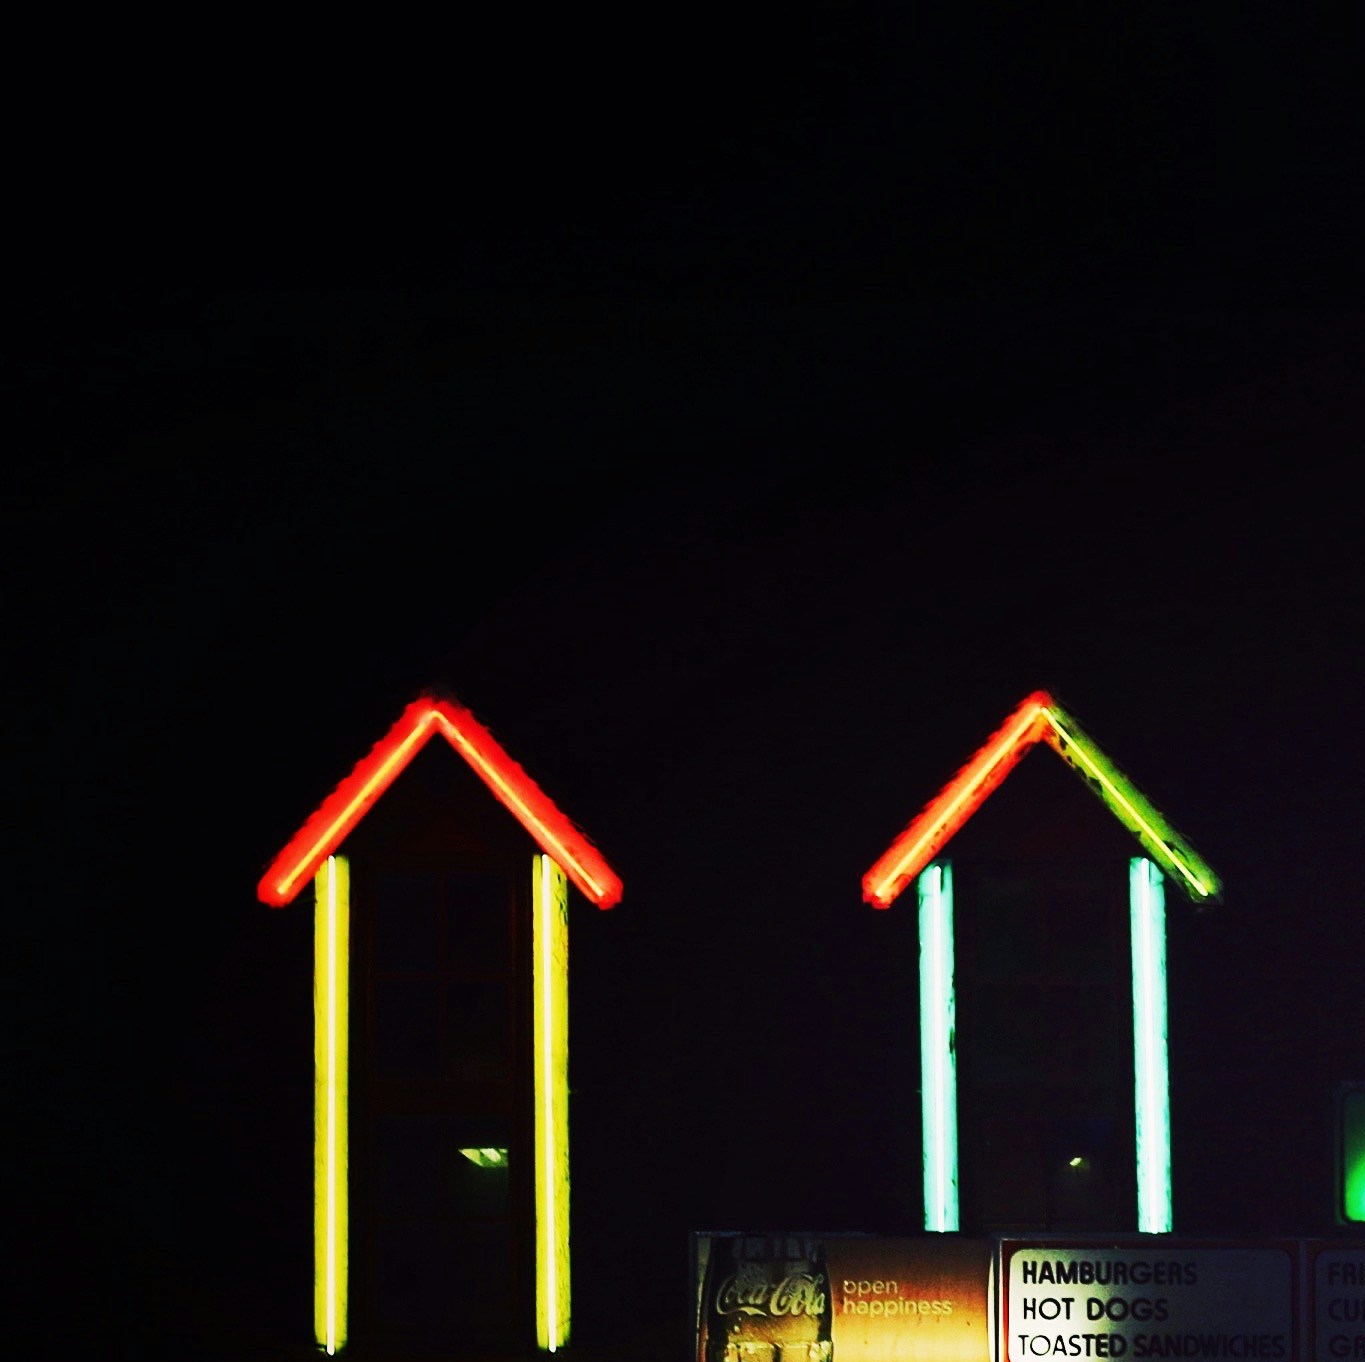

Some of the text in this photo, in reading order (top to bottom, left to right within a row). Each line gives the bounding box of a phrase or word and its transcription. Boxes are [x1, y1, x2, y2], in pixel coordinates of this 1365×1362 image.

[1022, 1260, 1199, 1286] HAMBURGERS
[716, 1273, 826, 1317] Coca-Cola
[843, 1279, 899, 1296] open
[842, 1298, 954, 1318] happiness
[1022, 1297, 1170, 1322] HOT DOGS
[1017, 1334, 1287, 1359] TOASTED SANDWICHES
